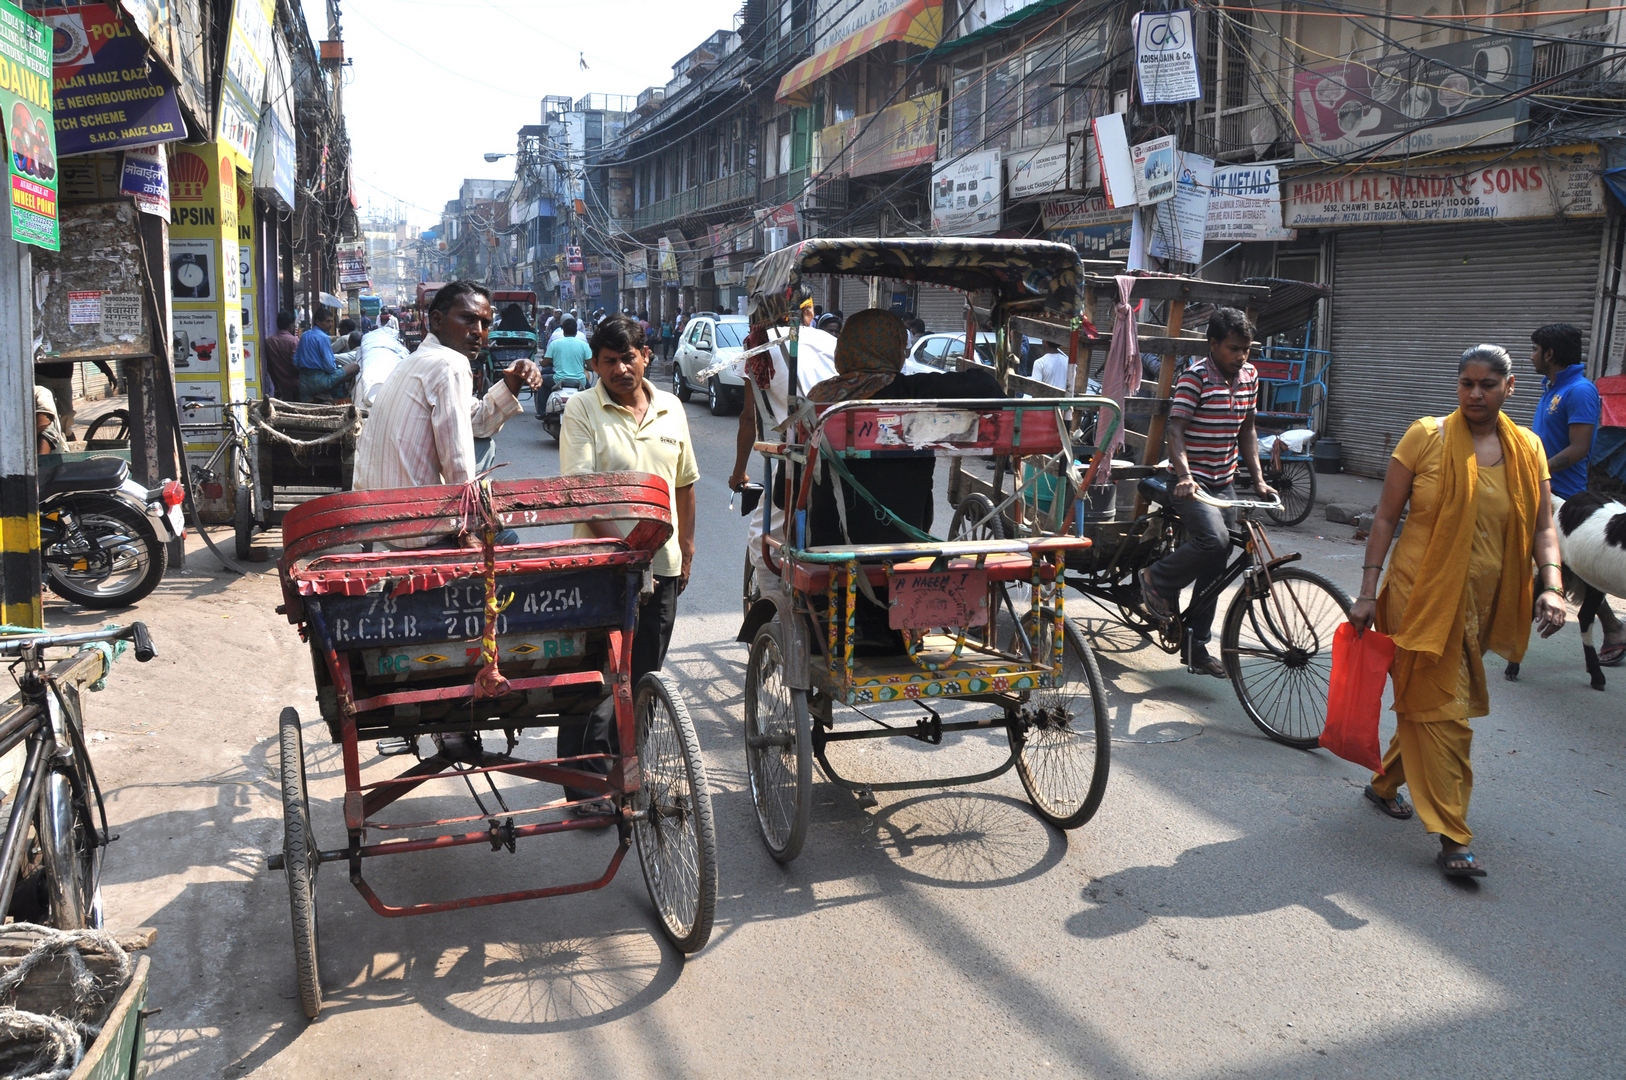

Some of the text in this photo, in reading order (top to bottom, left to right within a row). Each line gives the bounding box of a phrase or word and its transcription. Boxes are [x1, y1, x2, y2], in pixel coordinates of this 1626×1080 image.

[870, 9, 876, 21] &
[877, 2, 889, 18] CO.
[1472, 37, 1512, 49] TINNED COPPER
[1140, 51, 1193, 63] ADISH JAIN & Co.
[26, 55, 50, 79] WHEELS
[0, 56, 51, 112] DAIWA
[88, 71, 119, 86] HAUZ
[121, 68, 150, 82] QAZI
[68, 85, 165, 108] NEIGHBOURHOOD
[80, 110, 127, 128] SCHEME
[89, 122, 174, 144] S.H.O. HAUZ QAZI
[1405, 133, 1433, 148] SONS
[1036, 156, 1050, 165] LOCKING
[1228, 168, 1271, 196] METALS
[1293, 179, 1344, 205] MADAN
[1349, 177, 1383, 202] LAL
[1389, 172, 1455, 200] NANDA
[1459, 173, 1477, 195] &
[1482, 165, 1543, 194] SONS
[13, 188, 56, 217] WHEEL POINT
[1042, 199, 1070, 217] PANNA
[1341, 203, 1369, 212] CHAWRI
[1293, 213, 1330, 224] Distributors
[1342, 212, 1361, 222] METAL
[1363, 211, 1398, 221] EXTRUDERS
[1442, 208, 1460, 218] LTD.
[1461, 206, 1499, 218] (BOMBAY)
[896, 578, 905, 590] N
[961, 573, 969, 586] T
[523, 587, 583, 615] 4254
[336, 615, 422, 642] R.C.R.B.
[378, 653, 411, 675] RC
[543, 638, 575, 659] RB
